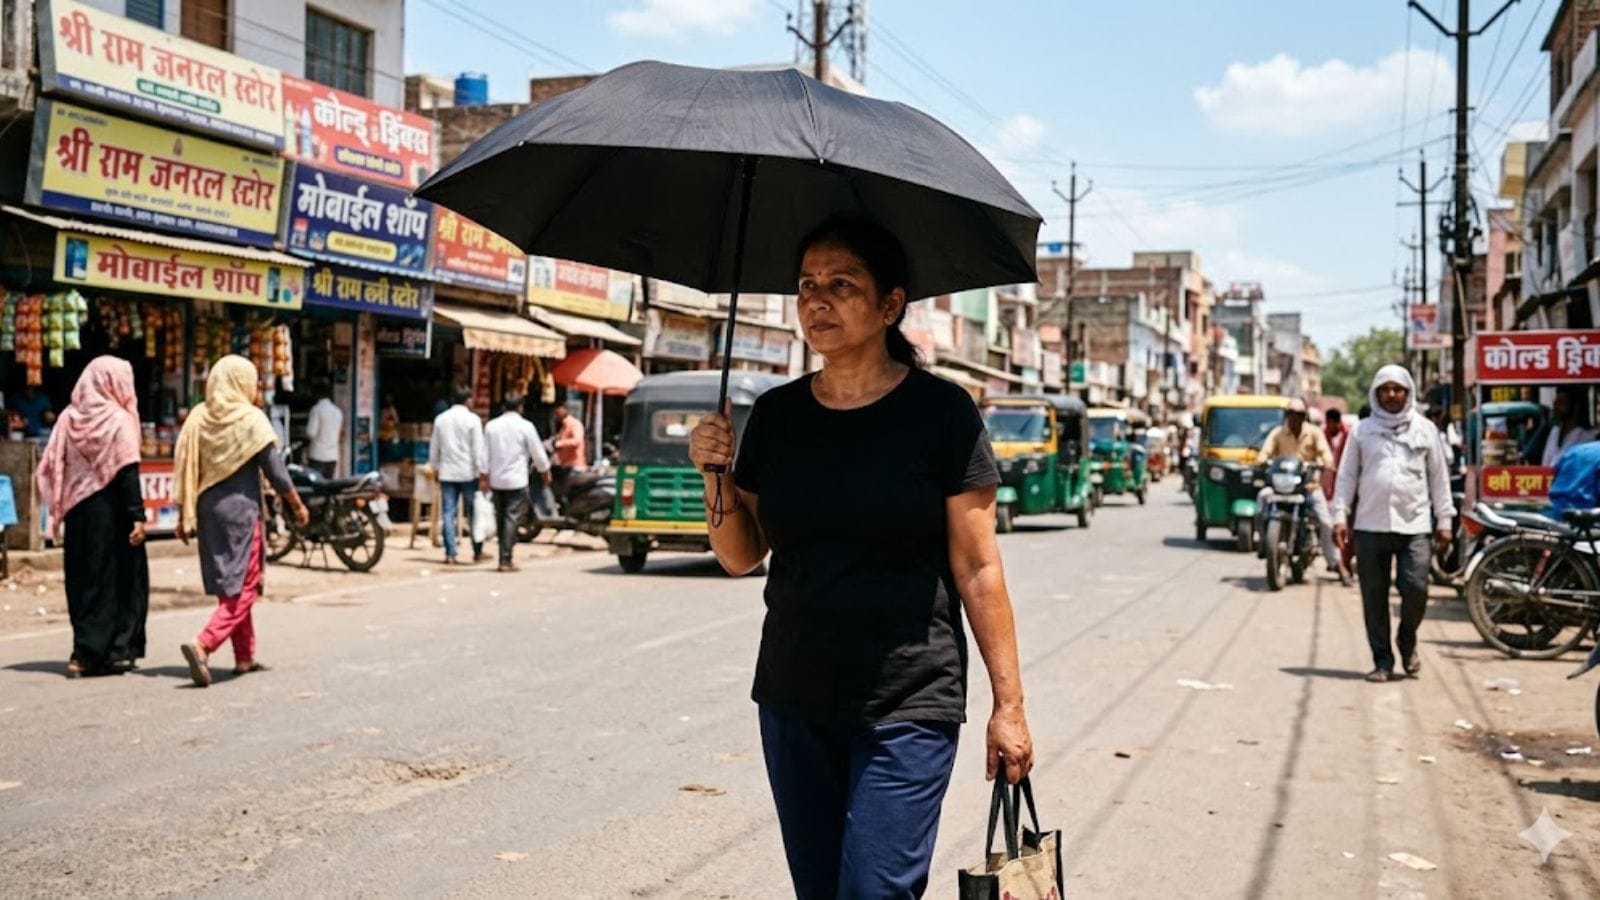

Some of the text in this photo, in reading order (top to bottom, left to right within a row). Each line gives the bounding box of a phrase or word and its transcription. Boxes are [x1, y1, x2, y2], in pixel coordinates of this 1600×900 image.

[59, 10, 94, 56] श्री
[100, 29, 144, 71] राम
[150, 45, 226, 97] जनरल
[232, 67, 275, 112] स्टोर
[57, 126, 93, 173] श्री
[99, 143, 144, 184] राम
[150, 155, 227, 202] जनरल
[231, 168, 275, 213] स्टोर
[386, 193, 428, 241] शॉप
[96, 243, 263, 296] मोबाईल शॉप
[1483, 338, 1551, 370] कोल्ड
